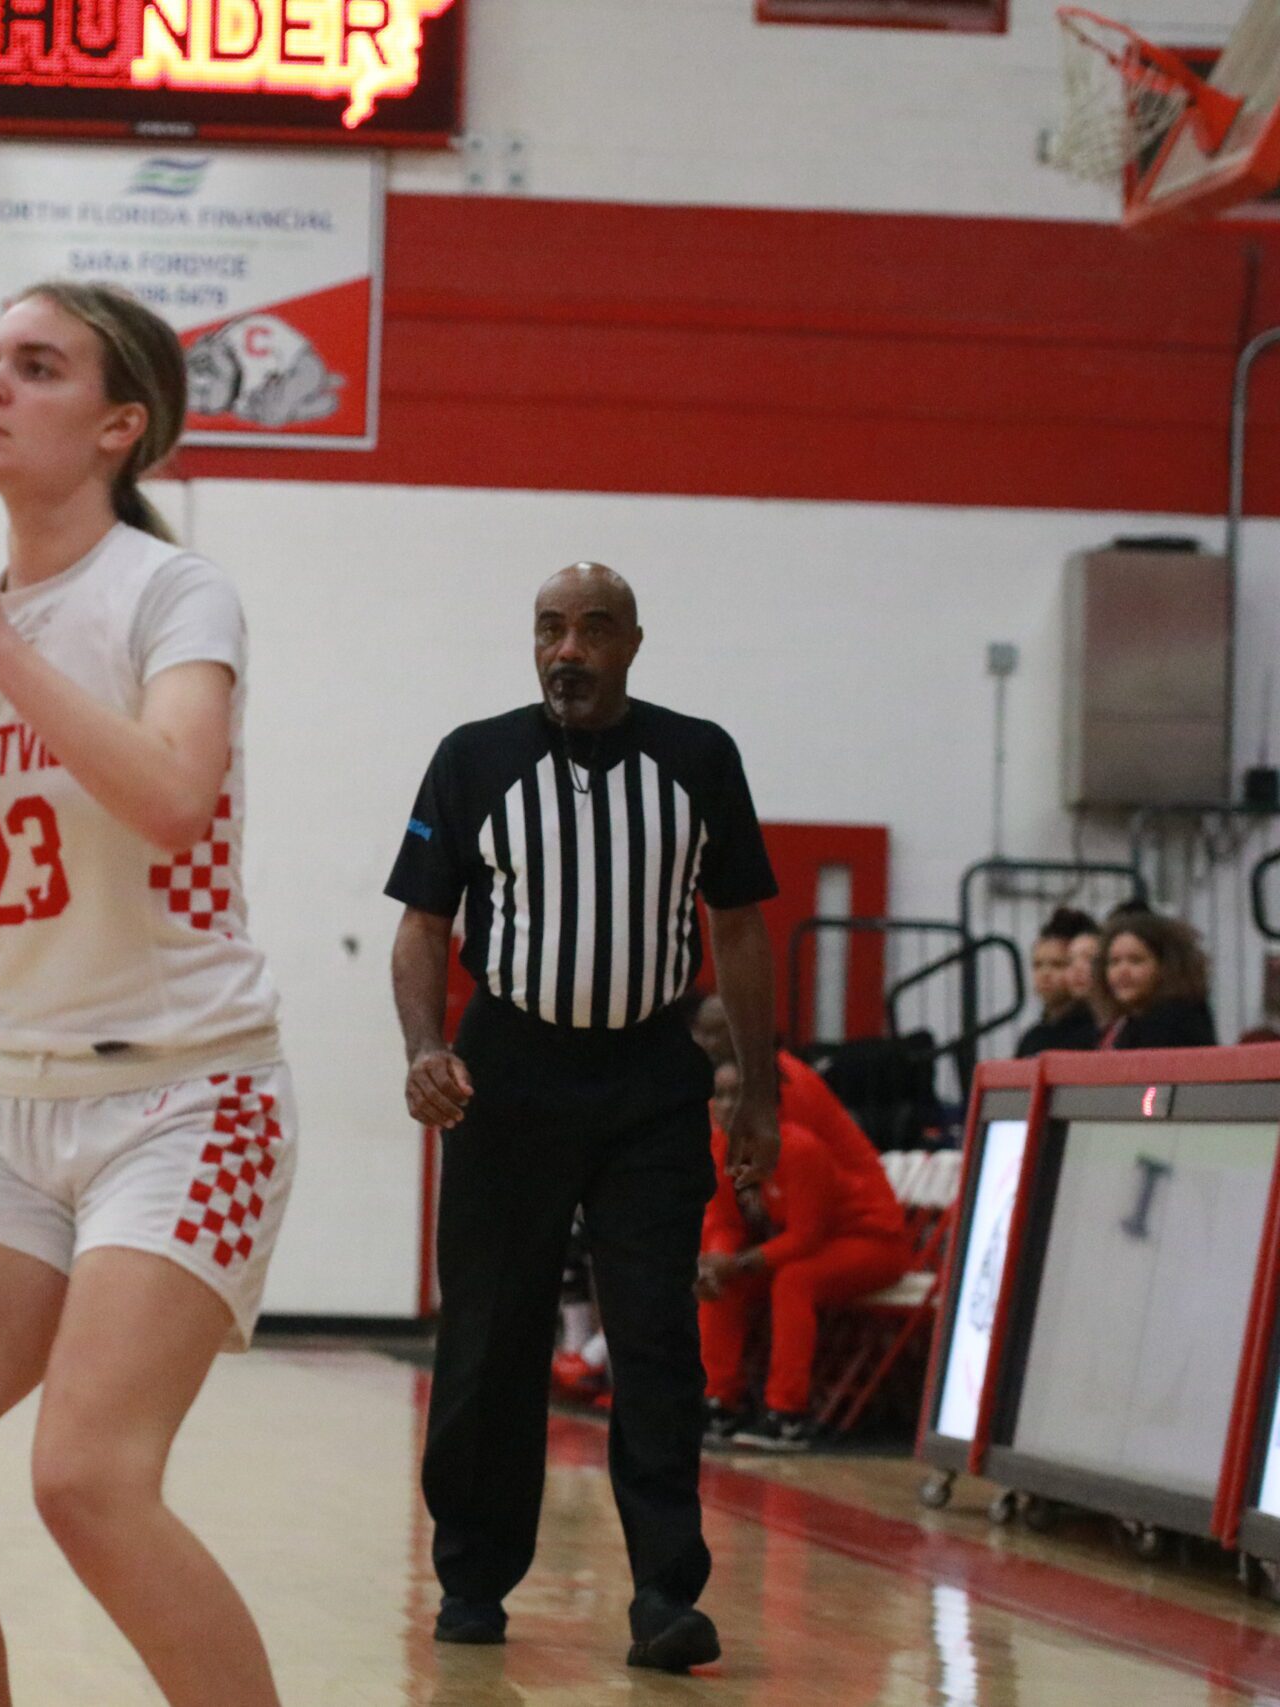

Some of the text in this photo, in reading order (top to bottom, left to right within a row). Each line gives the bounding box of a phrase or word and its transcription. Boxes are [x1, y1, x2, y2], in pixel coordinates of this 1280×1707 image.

[77, 203, 192, 227] FLORIDA
[198, 206, 334, 233] FINANCIAL
[243, 326, 271, 357] C
